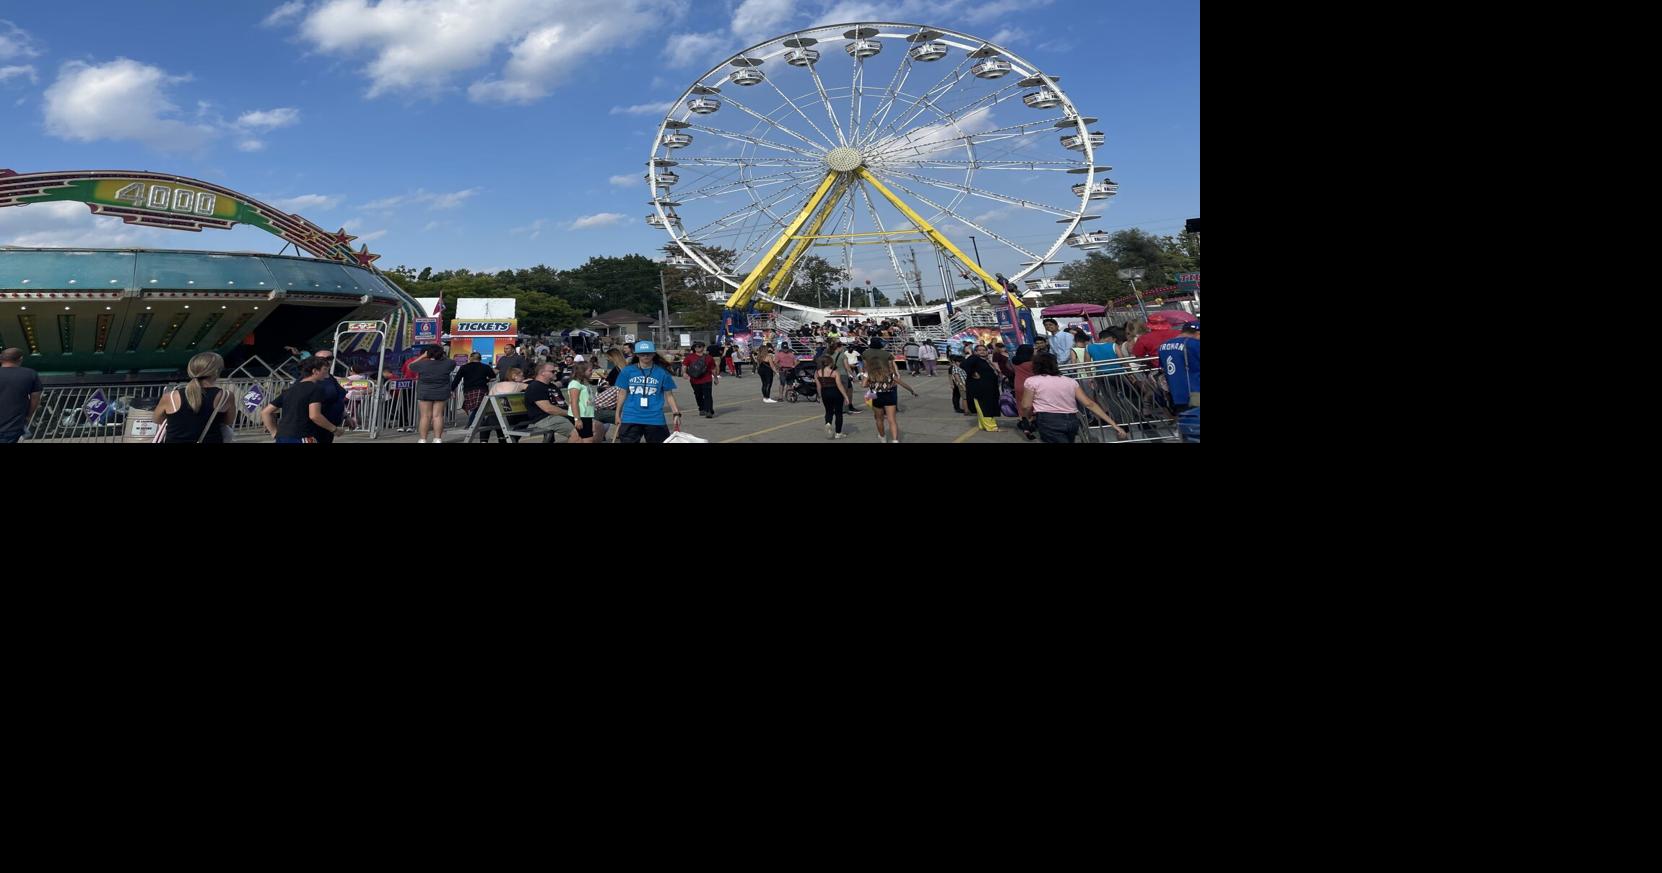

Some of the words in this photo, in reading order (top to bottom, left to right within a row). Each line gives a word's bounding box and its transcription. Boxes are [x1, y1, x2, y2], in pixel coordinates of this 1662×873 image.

[115, 182, 216, 216] 4000
[457, 322, 512, 332] TICKETS
[1167, 355, 1176, 375] 6
[629, 376, 659, 385] WESTERN
[629, 385, 658, 396] FAIR
